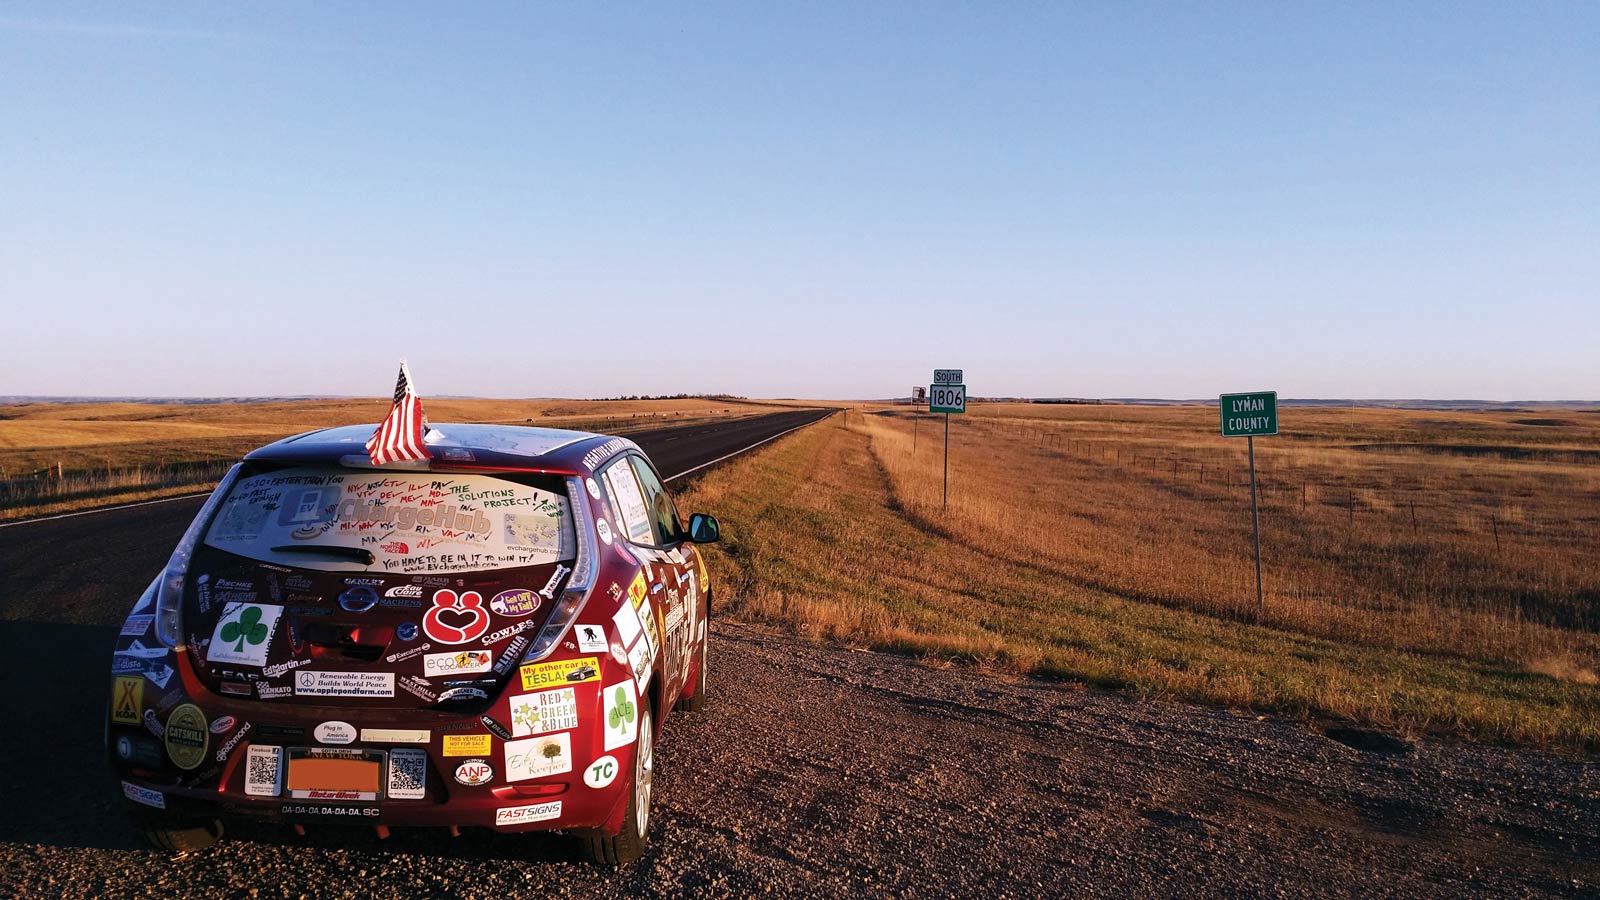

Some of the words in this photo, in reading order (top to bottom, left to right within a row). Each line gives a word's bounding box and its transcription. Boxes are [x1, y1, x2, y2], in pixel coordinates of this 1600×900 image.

[936, 372, 960, 381] SOUTH
[934, 390, 962, 406] 1806
[1232, 399, 1264, 412] LYMAN
[1229, 417, 1269, 430] COUNTY
[449, 485, 470, 494] THE
[458, 489, 514, 502] SOLUTIONS
[300, 504, 315, 512] EV
[337, 499, 491, 534] ChargeHub
[402, 555, 424, 566] HAVE
[440, 554, 453, 562] BE
[482, 620, 534, 644] COWLES
[500, 635, 525, 664] LITHIA
[262, 659, 312, 678] EdMartin.com
[426, 658, 454, 668] eco
[523, 666, 536, 675] My
[540, 662, 562, 673] other
[525, 671, 565, 686] TESLA!
[296, 687, 392, 695] www.applepondfarm.com
[540, 692, 562, 706] RED
[116, 710, 138, 719] KOA
[541, 704, 576, 719] GREEN
[612, 704, 630, 720] ACE
[542, 716, 577, 732] &BLUE
[169, 727, 204, 742] CATSKILL
[458, 766, 490, 777] ANP
[593, 762, 612, 781] TC
[498, 804, 560, 818] FASTSIGNS
